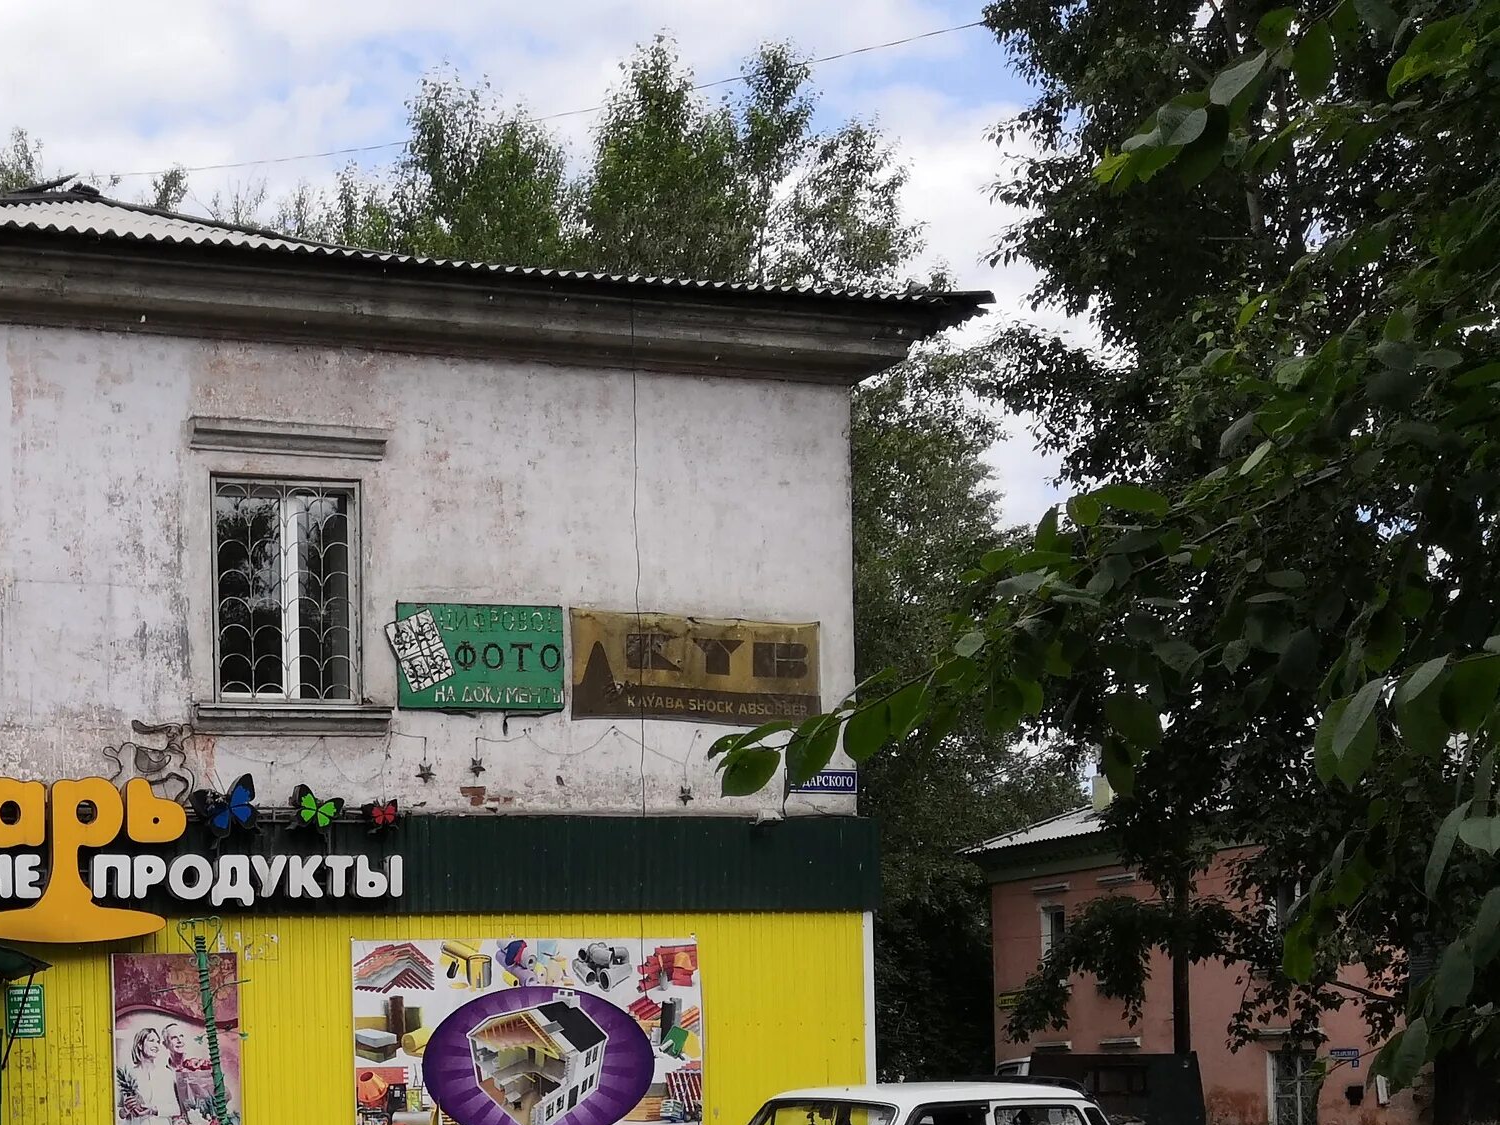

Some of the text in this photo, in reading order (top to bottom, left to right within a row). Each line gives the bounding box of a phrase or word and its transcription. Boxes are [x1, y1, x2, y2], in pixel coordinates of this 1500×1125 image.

[440, 608, 559, 632] ЦИФРОВОЕ
[454, 641, 562, 673] ФОТО
[626, 633, 809, 679] KYB
[434, 685, 565, 705] НА ДОКУМЕНТЫ
[627, 694, 685, 710] KAYABA
[688, 698, 735, 714] SHOCK
[92, 853, 404, 907] ПРОДУКТЫ
